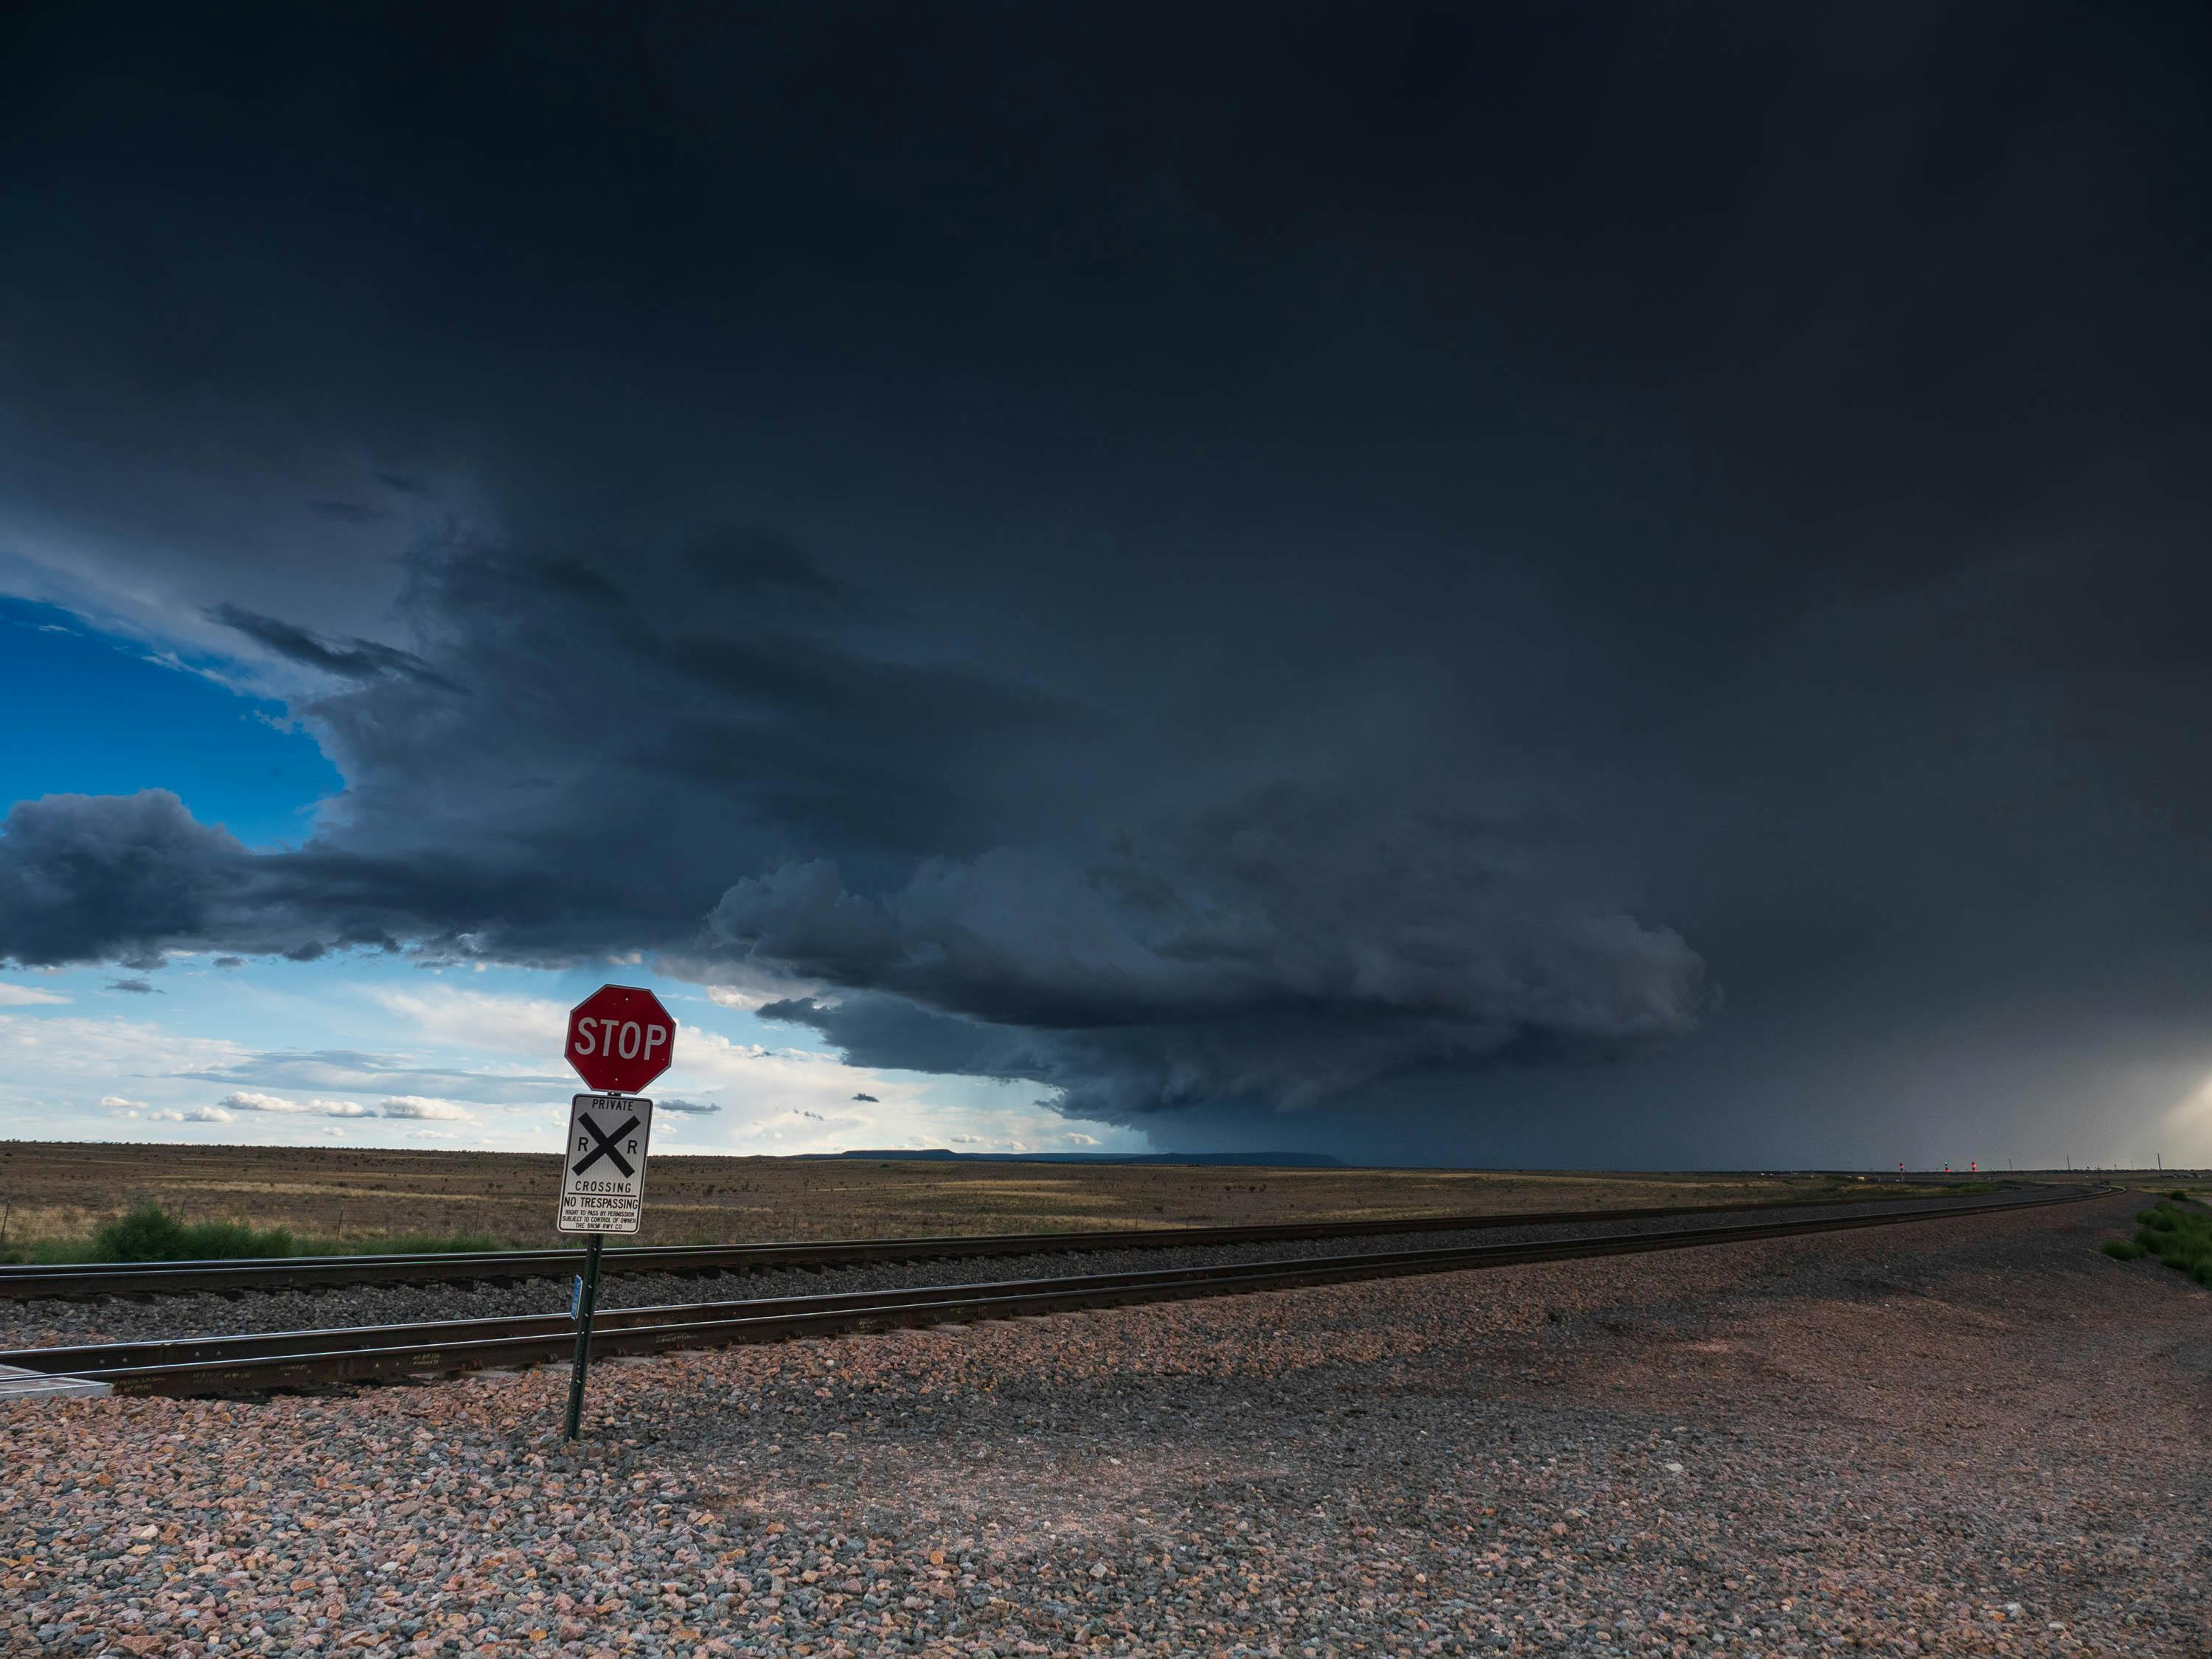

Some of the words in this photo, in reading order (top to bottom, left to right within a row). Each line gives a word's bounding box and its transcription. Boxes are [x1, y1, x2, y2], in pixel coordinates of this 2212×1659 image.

[574, 1017, 667, 1060] STOP
[592, 1099, 633, 1111] PRIVATE
[577, 1137, 588, 1152] R
[627, 1140, 638, 1154] R
[575, 1180, 631, 1193] CROSSING
[563, 1196, 577, 1207] NO
[580, 1197, 639, 1209] TRESPASSING
